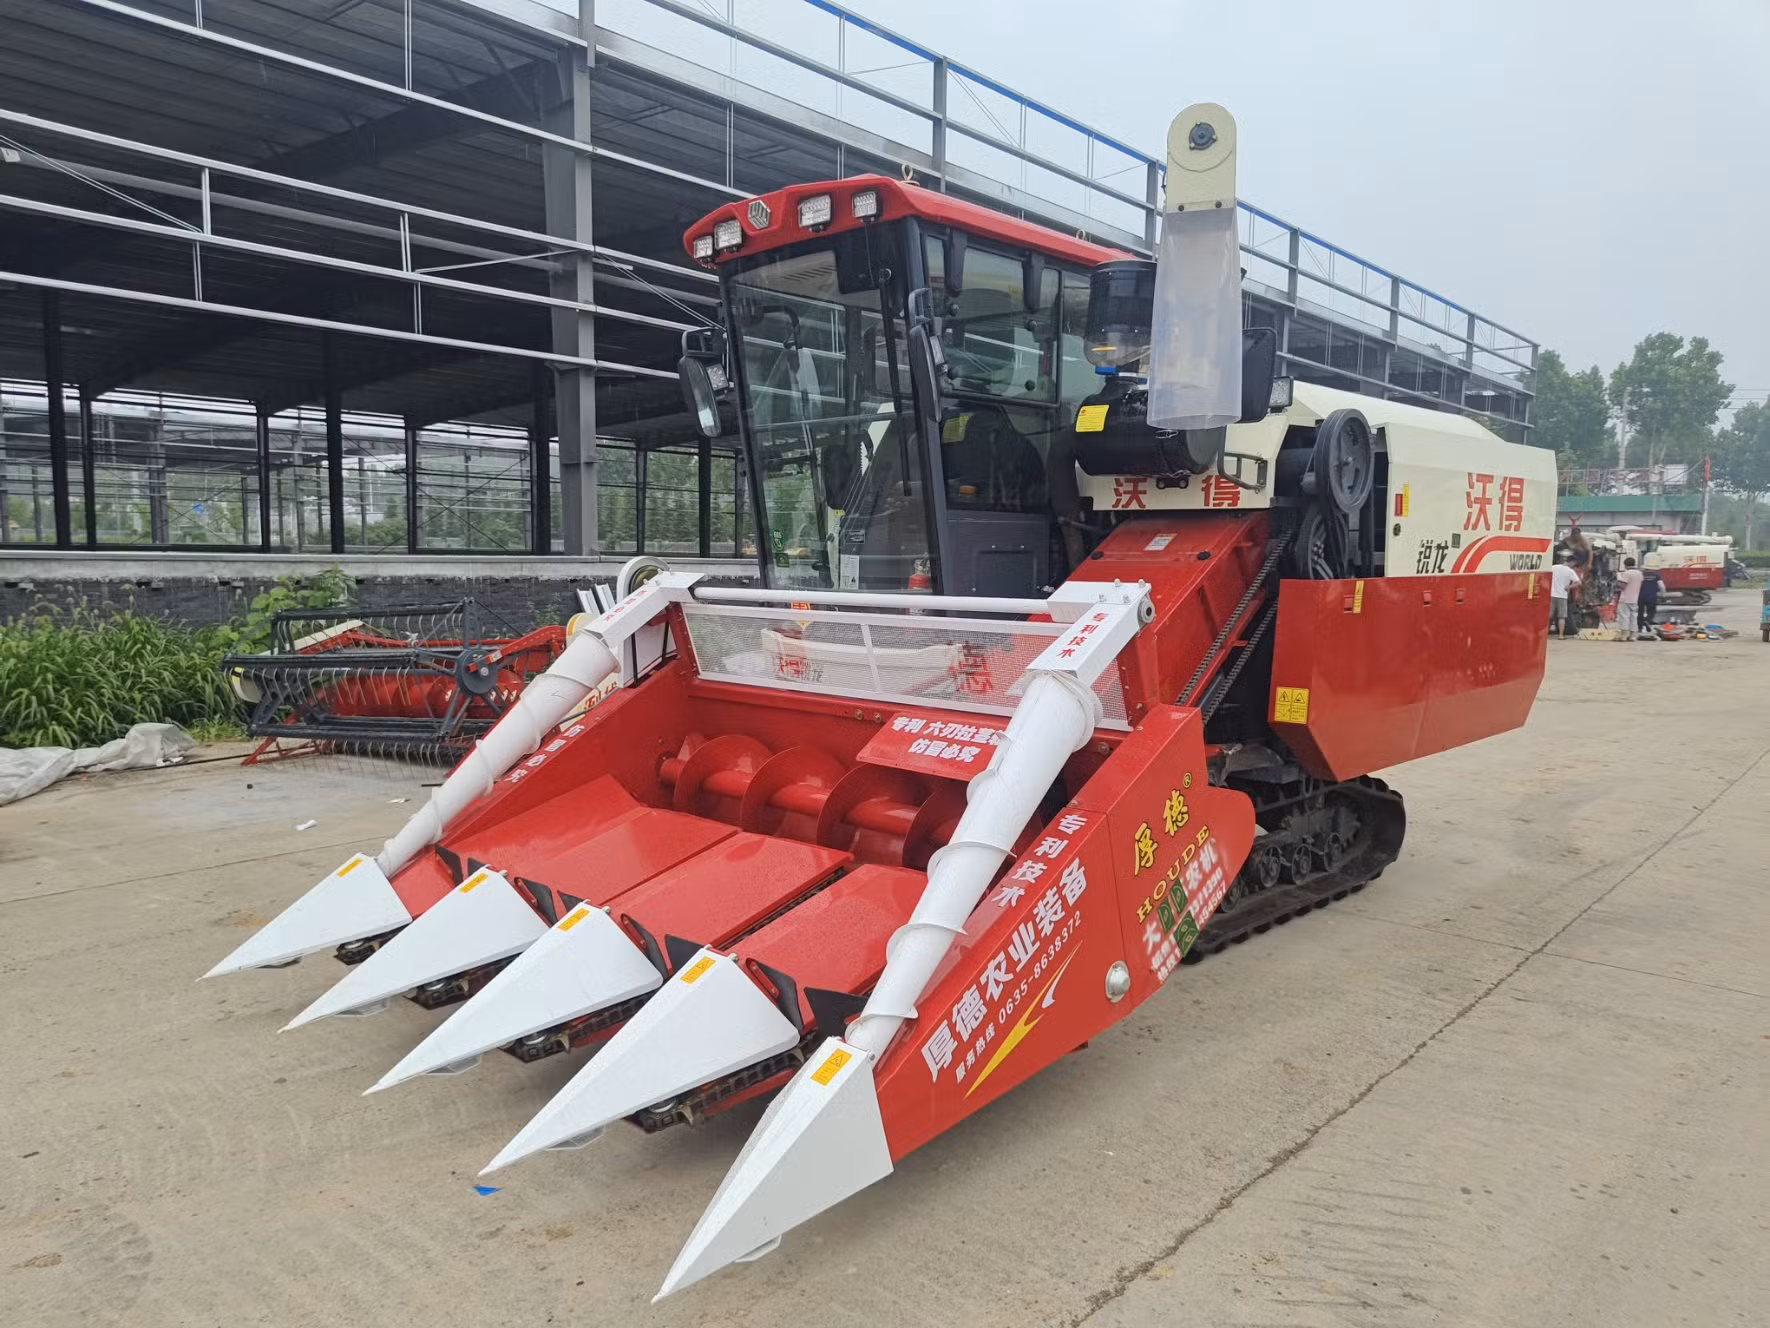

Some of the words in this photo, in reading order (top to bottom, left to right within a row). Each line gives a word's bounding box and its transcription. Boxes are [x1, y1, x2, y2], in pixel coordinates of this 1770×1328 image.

[1111, 474, 1242, 509] 沃得
[1463, 472, 1525, 532] 沃得
[1509, 554, 1543, 570] WORLD
[992, 814, 1088, 908] 专利技术
[1136, 826, 1210, 924] HOUDE
[1142, 837, 1218, 957] 大农机
[920, 857, 1088, 1083] 厚德农业装备
[955, 1027, 996, 1085] 服务热线
[998, 910, 1082, 1024] 0635-8638372
